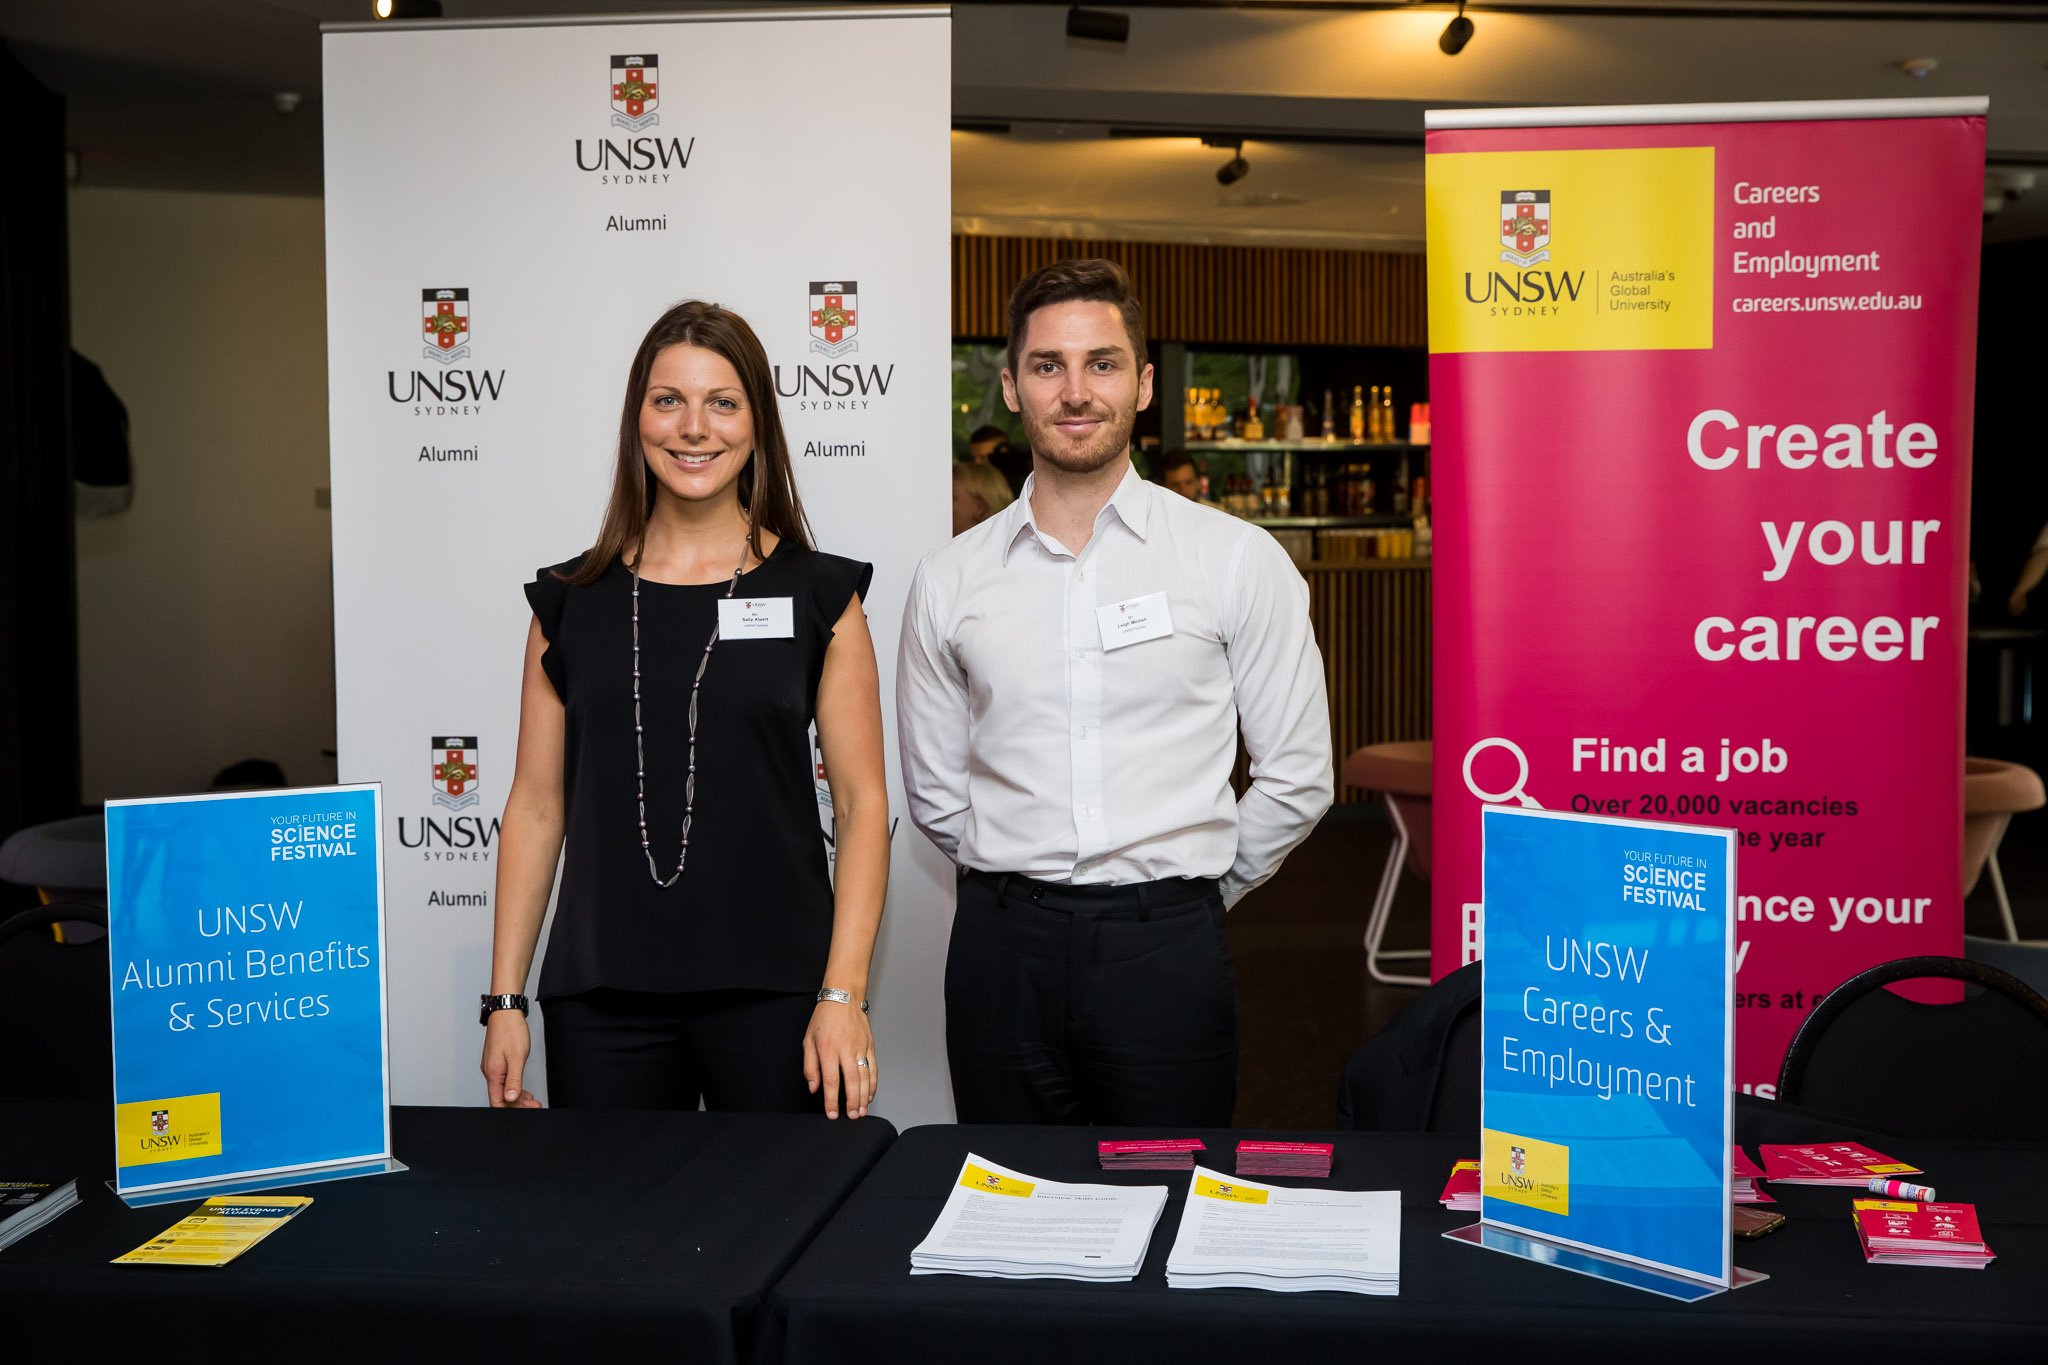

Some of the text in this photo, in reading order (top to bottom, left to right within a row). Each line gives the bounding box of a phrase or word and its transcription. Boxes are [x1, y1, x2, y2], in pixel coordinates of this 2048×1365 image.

[576, 137, 695, 171] UNSW
[602, 174, 670, 184] SYDNEY
[1733, 182, 1820, 204] Careers
[606, 214, 667, 232] Alumni
[1733, 216, 1775, 239] and
[1733, 250, 1880, 279] Employment
[1465, 271, 1585, 303] UNSW
[1610, 270, 1675, 282] Australia's
[1610, 285, 1650, 296] Global
[1733, 291, 1922, 312] careers.unsw.edu.au
[1490, 306, 1560, 316] SYDNEY
[1610, 299, 1671, 312] University
[388, 370, 505, 402] UNSW
[774, 364, 894, 397] UNSW
[414, 406, 481, 416] SYDNEY
[800, 400, 869, 410] SYDNEY
[804, 440, 866, 457] Alumni
[1687, 409, 1938, 470] Create
[418, 445, 478, 462] Alumni
[1760, 519, 1941, 582] your
[1694, 615, 1940, 662] career
[1572, 738, 1788, 782] Find a job
[1571, 794, 1858, 818] Over 20,000 vacancies
[270, 811, 356, 826] YOUR FUTURE IN
[398, 816, 501, 848] UNSW
[1769, 831, 1825, 853] year
[271, 842, 357, 862] FESTIVAL
[424, 852, 490, 861] SYDNEY
[1623, 849, 1706, 869] YOUR FUTURE IN
[428, 890, 487, 906] Alumni
[1623, 884, 1706, 912] FESTIVAL
[198, 900, 303, 938] UNSW
[1829, 896, 1932, 932] your
[121, 940, 370, 991] Alumni Benefits
[1546, 935, 1649, 984] UNSW
[1780, 990, 1804, 1009] at
[168, 992, 330, 1032] & Services
[1523, 986, 1672, 1046] Careers &
[1503, 1036, 1696, 1108] Employment
[140, 1134, 181, 1150] UNSW
[976, 1180, 1005, 1191] UNSW
[1501, 1172, 1535, 1191] UNSW
